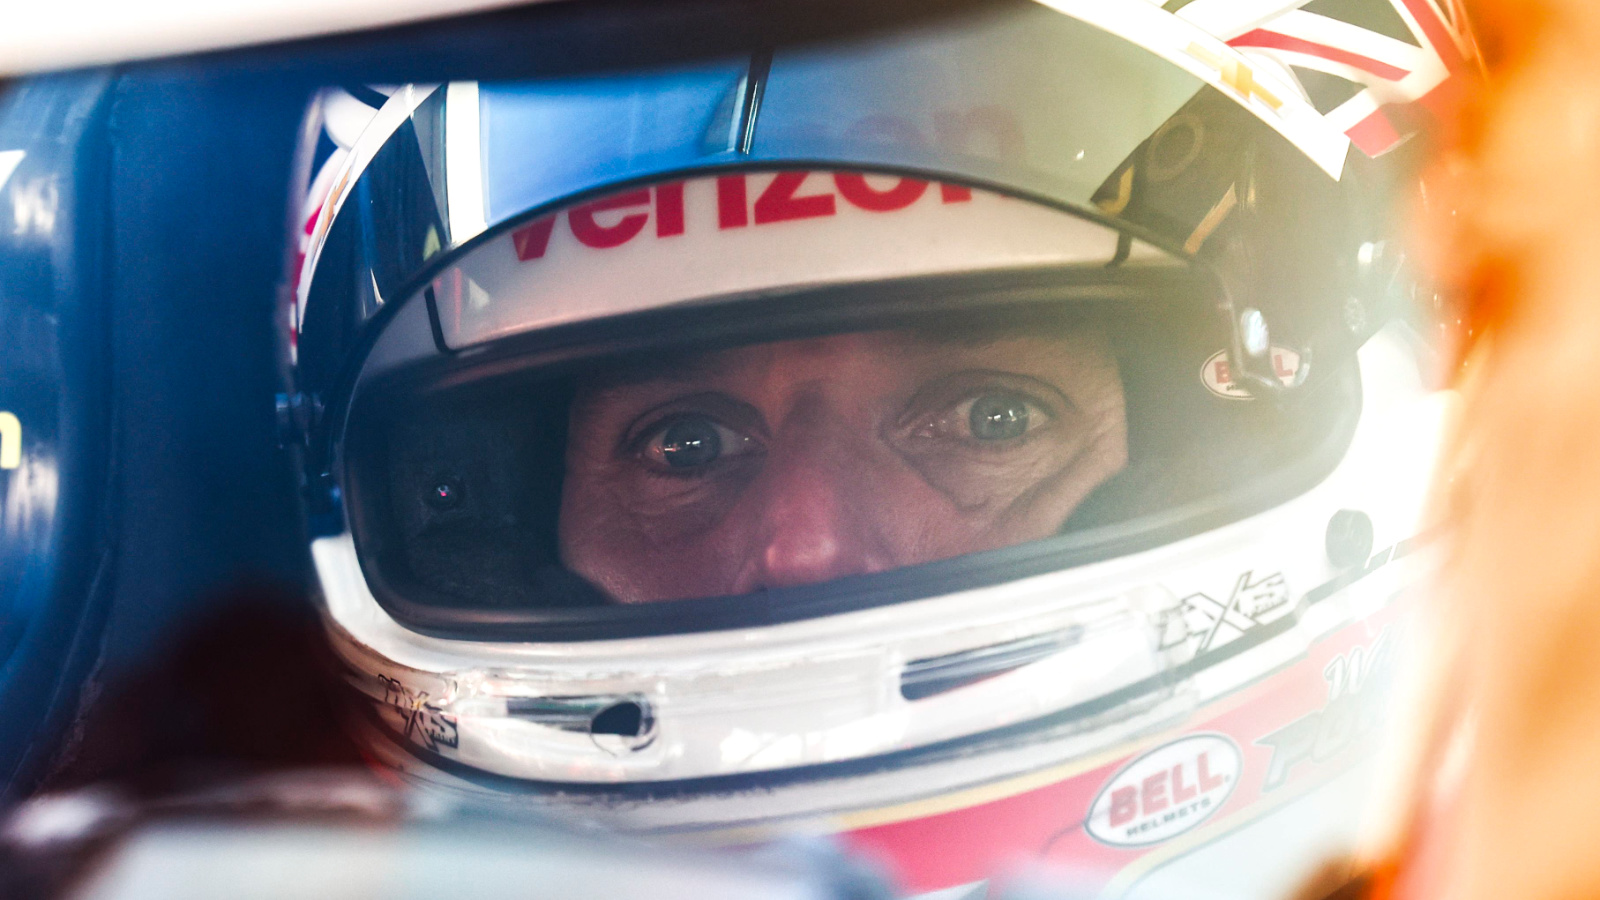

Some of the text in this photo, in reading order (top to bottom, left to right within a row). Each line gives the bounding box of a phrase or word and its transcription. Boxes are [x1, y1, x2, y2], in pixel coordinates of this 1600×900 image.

[1214, 354, 1294, 384] BL
[1108, 751, 1224, 829] BELL
[1126, 797, 1213, 839] HELMETS
